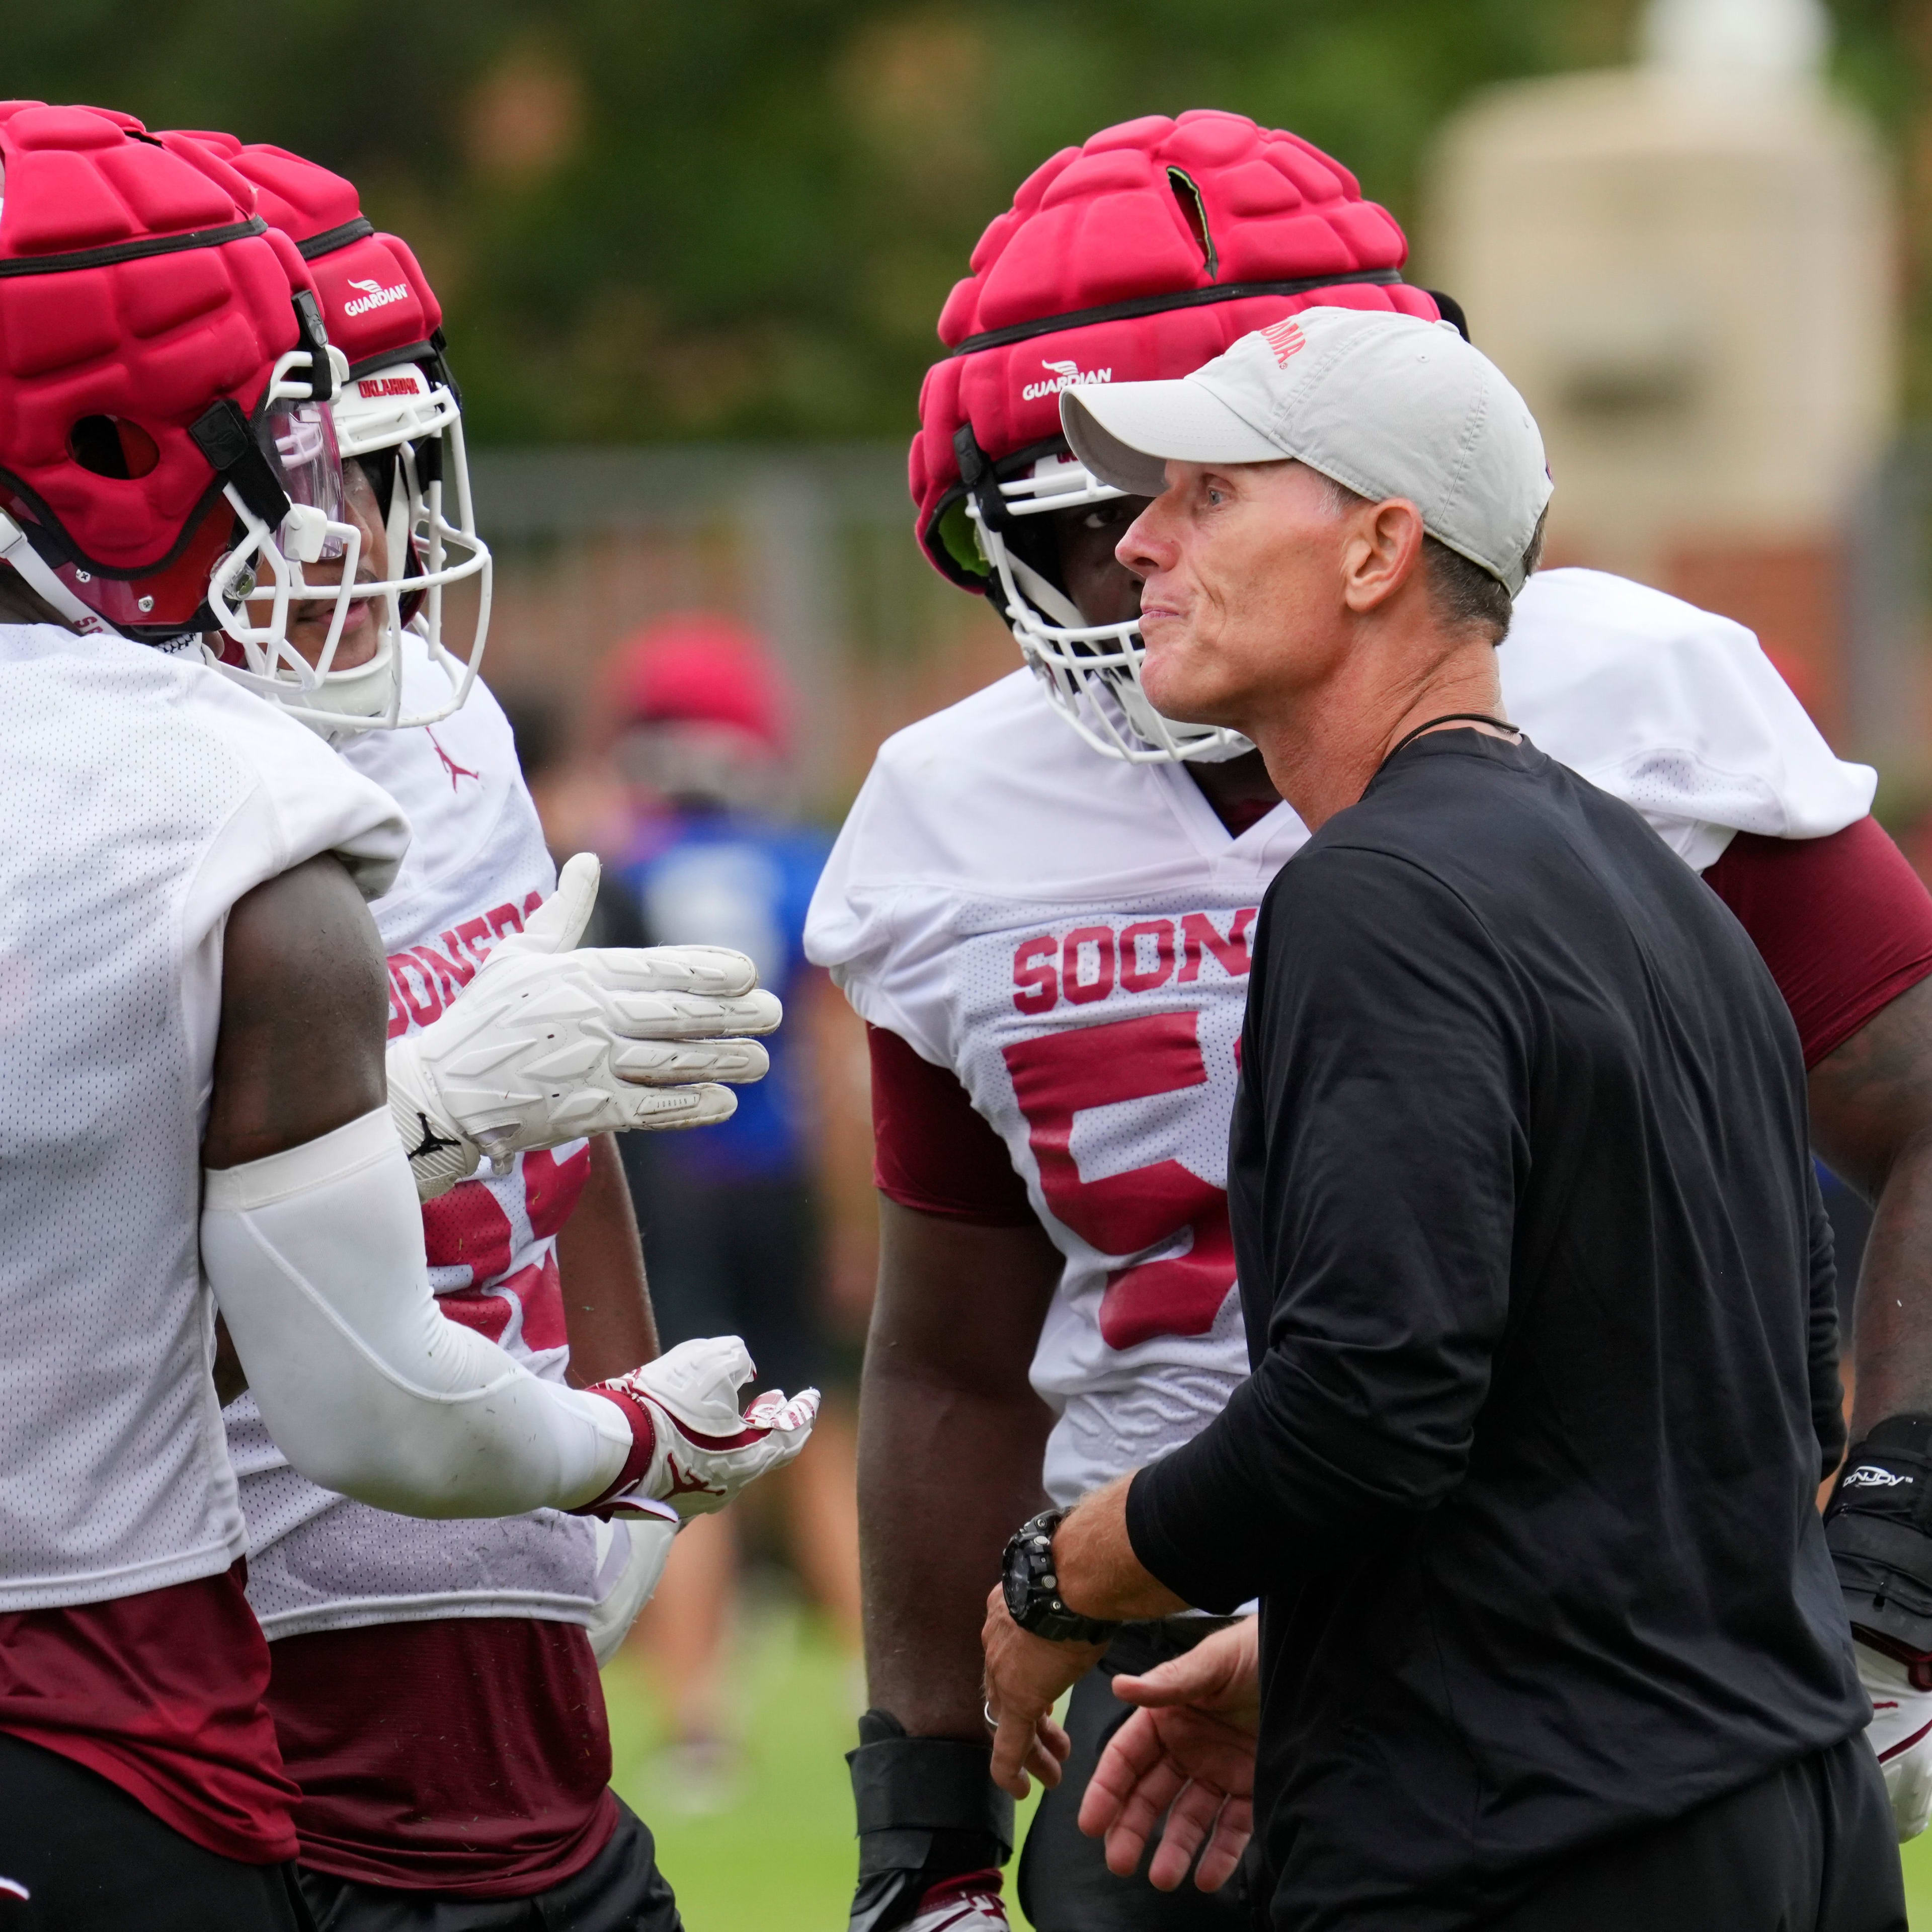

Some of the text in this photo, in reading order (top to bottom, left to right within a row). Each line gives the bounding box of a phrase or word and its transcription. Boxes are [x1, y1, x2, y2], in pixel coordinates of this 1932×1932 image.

[344, 284, 408, 316] GUARDIAN
[358, 377, 420, 398] OKLAHOMA
[1022, 367, 1112, 400] GUARDIAN
